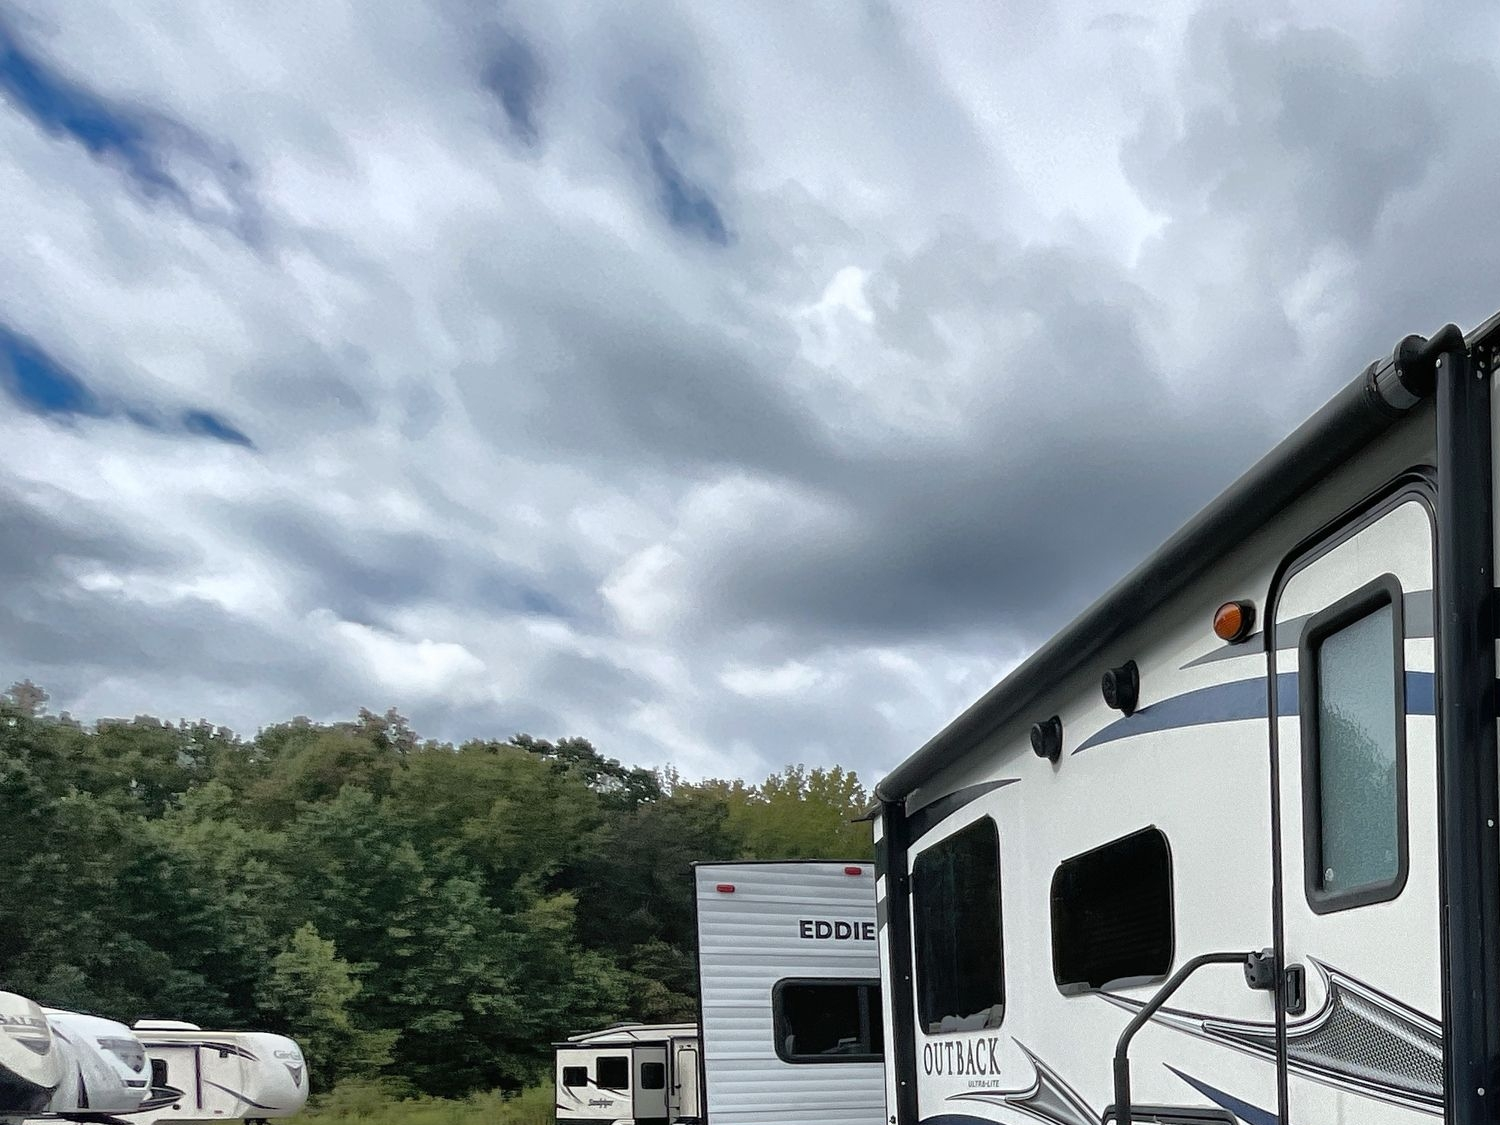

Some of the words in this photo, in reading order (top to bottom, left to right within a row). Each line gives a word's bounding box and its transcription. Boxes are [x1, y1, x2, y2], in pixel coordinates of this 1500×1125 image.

[799, 919, 876, 941] EDDIE
[923, 1037, 1002, 1076] OUTBACK
[967, 1079, 1000, 1088] ULTRA-LITE
